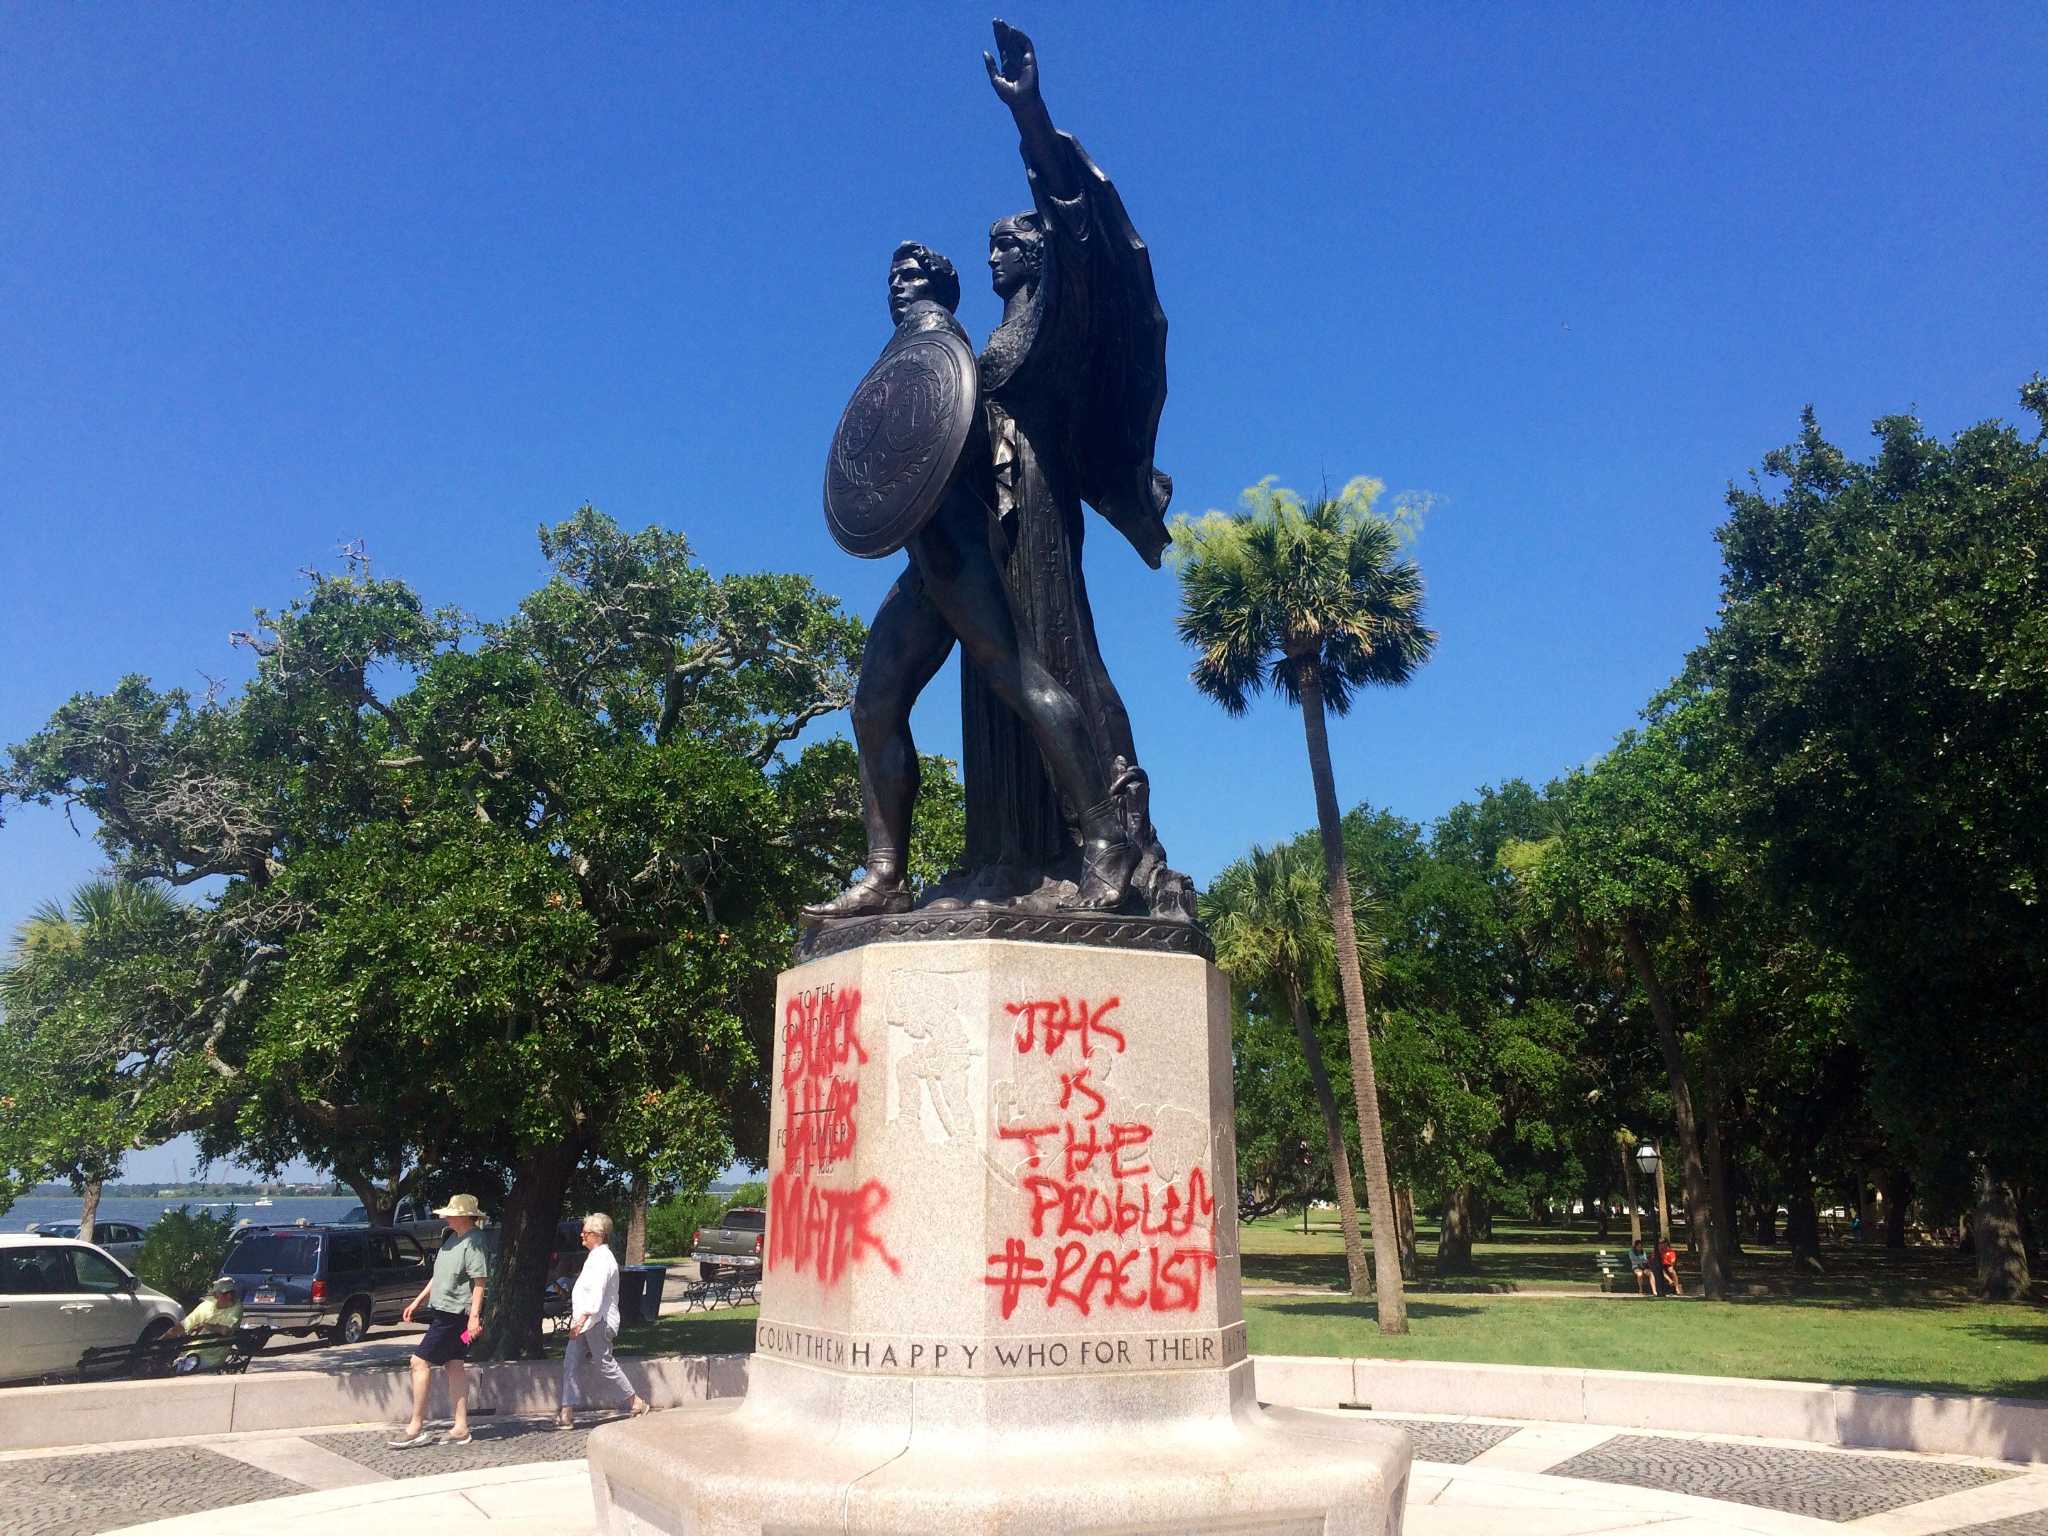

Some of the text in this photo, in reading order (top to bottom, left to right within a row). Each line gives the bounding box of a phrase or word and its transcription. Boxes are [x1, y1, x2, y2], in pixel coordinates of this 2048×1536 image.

[798, 983, 835, 1010] TO THE
[1060, 1067, 1105, 1120] IS
[998, 1121, 1152, 1181] THE
[985, 1237, 1218, 1320] #RACIST
[758, 1326, 801, 1356] COUNT
[806, 1334, 844, 1365] THEM
[852, 1342, 978, 1369] HAPPY
[995, 1342, 1068, 1368] WHO
[1081, 1340, 1132, 1365] FOR
[1146, 1337, 1215, 1362] THEIR
